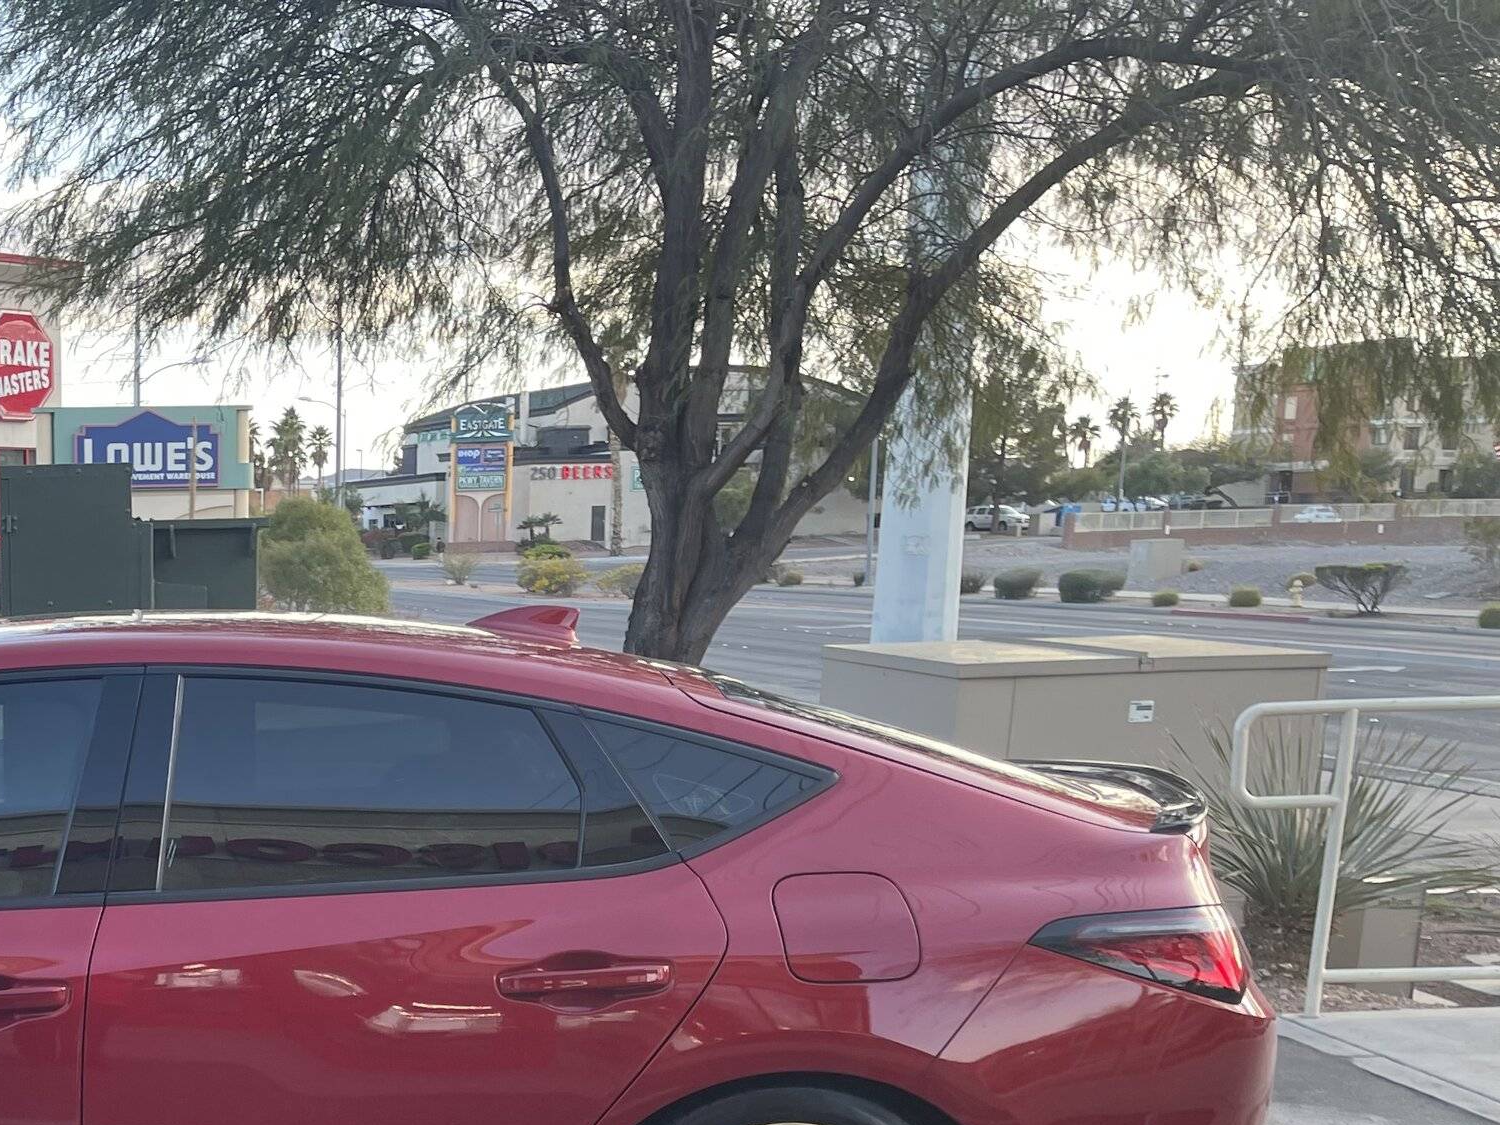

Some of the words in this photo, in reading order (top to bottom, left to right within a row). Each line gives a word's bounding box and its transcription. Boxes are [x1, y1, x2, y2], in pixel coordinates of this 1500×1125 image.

[460, 417, 505, 431] EASTGATE
[84, 436, 214, 471] LOWE'S
[132, 473, 164, 481] VEMENT
[166, 472, 216, 481] WAREOUSE
[530, 466, 557, 481] 250
[561, 465, 613, 480] BEERS
